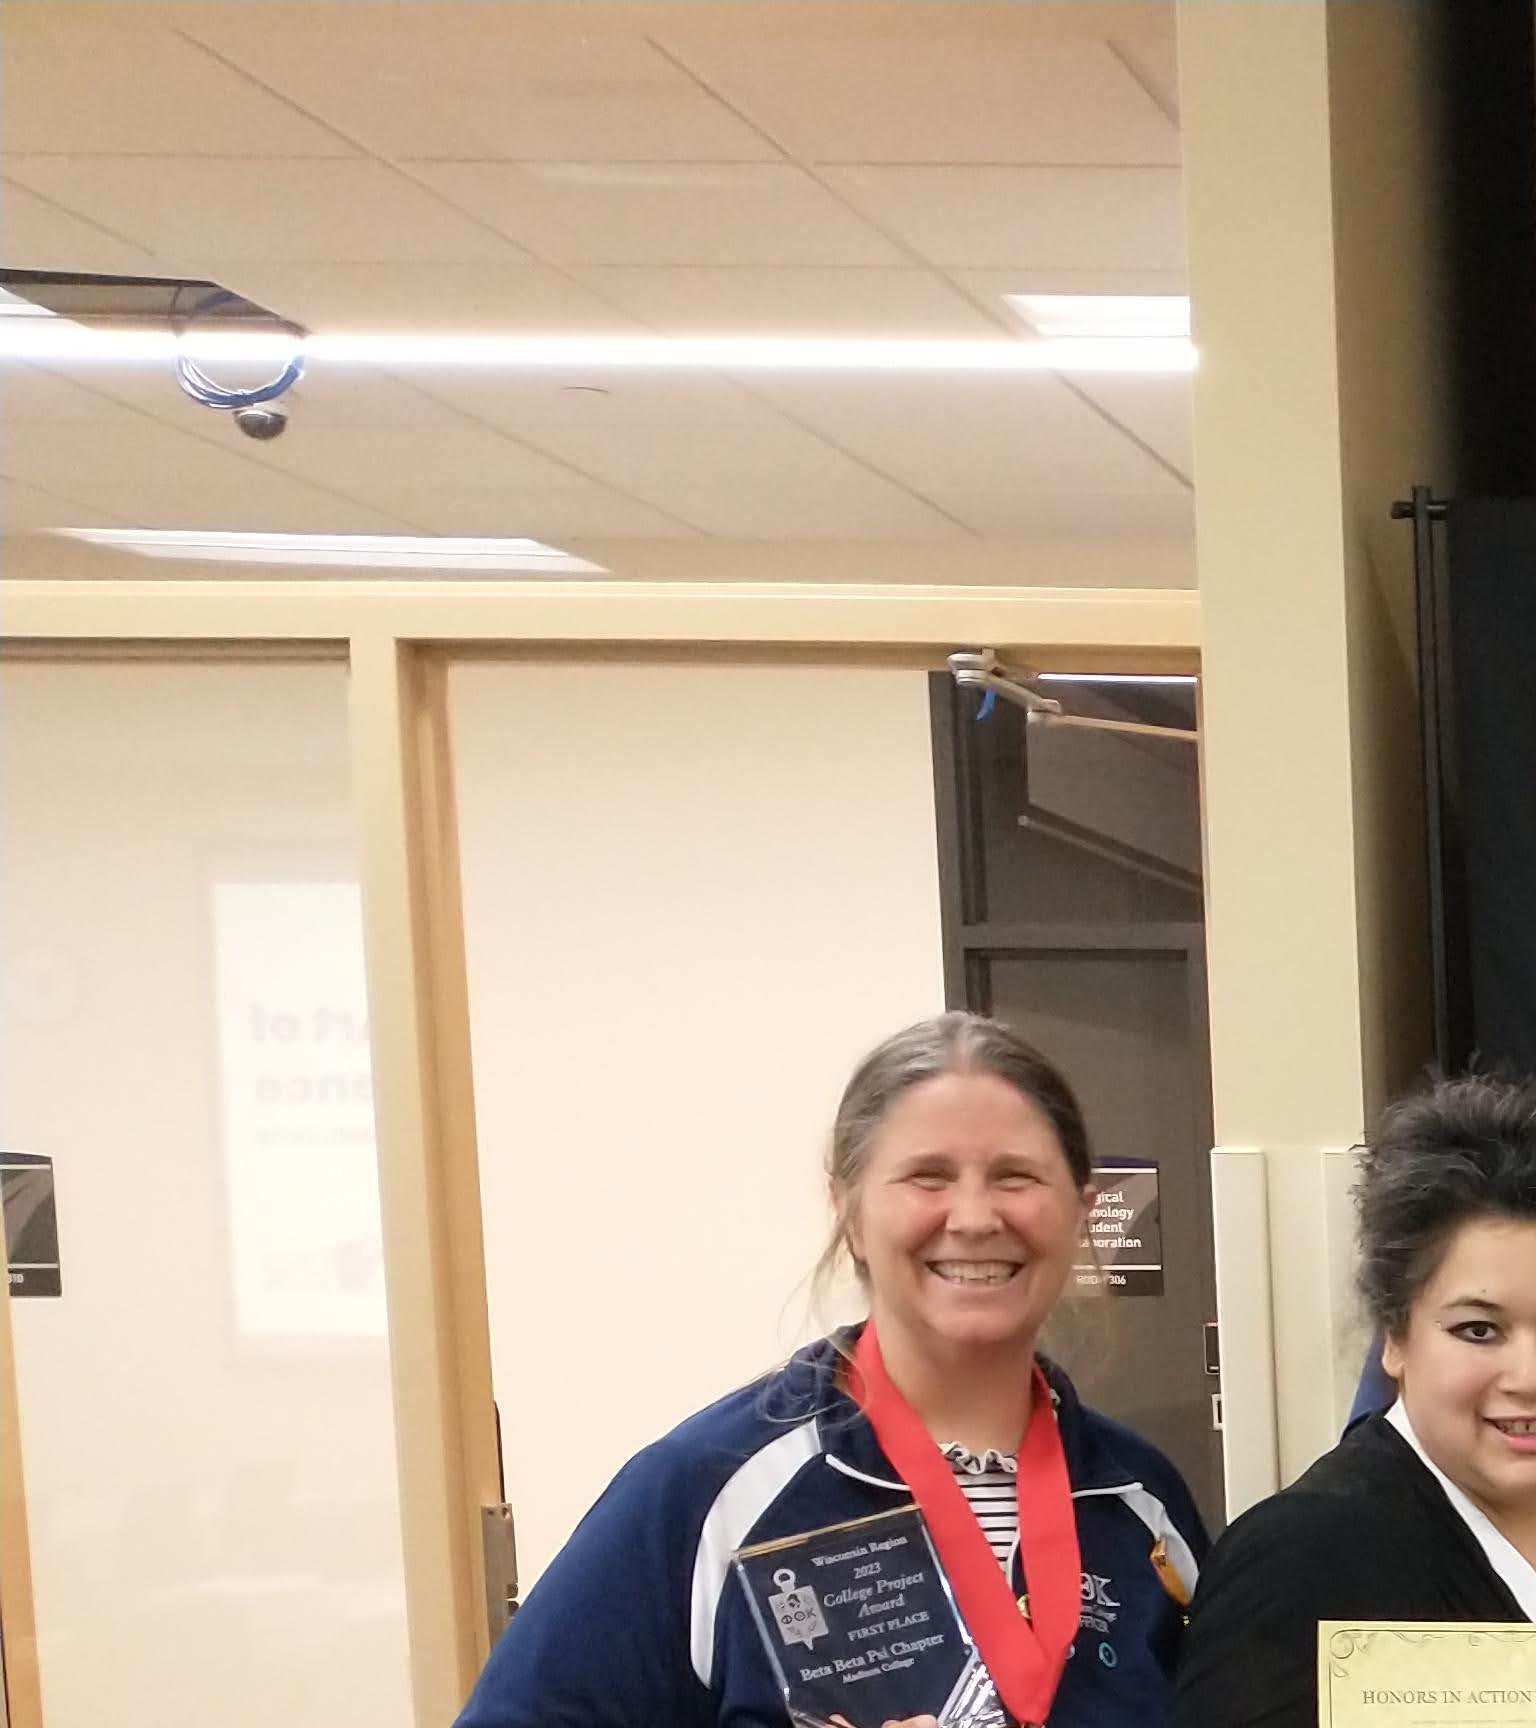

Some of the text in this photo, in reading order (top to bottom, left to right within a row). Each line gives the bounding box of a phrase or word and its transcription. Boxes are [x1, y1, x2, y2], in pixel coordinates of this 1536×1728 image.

[853, 1562, 882, 1579] 2023
[823, 1572, 925, 1607] College Project
[858, 1593, 905, 1618] Award
[848, 1611, 930, 1641] FIRST PLACE
[800, 1665, 833, 1682] Beta
[833, 1655, 867, 1673] Beta
[890, 1634, 945, 1656] Chapter
[1362, 1689, 1438, 1705] HONORS
[1442, 1690, 1463, 1704] IN
[1470, 1689, 1532, 1704] ACTION
